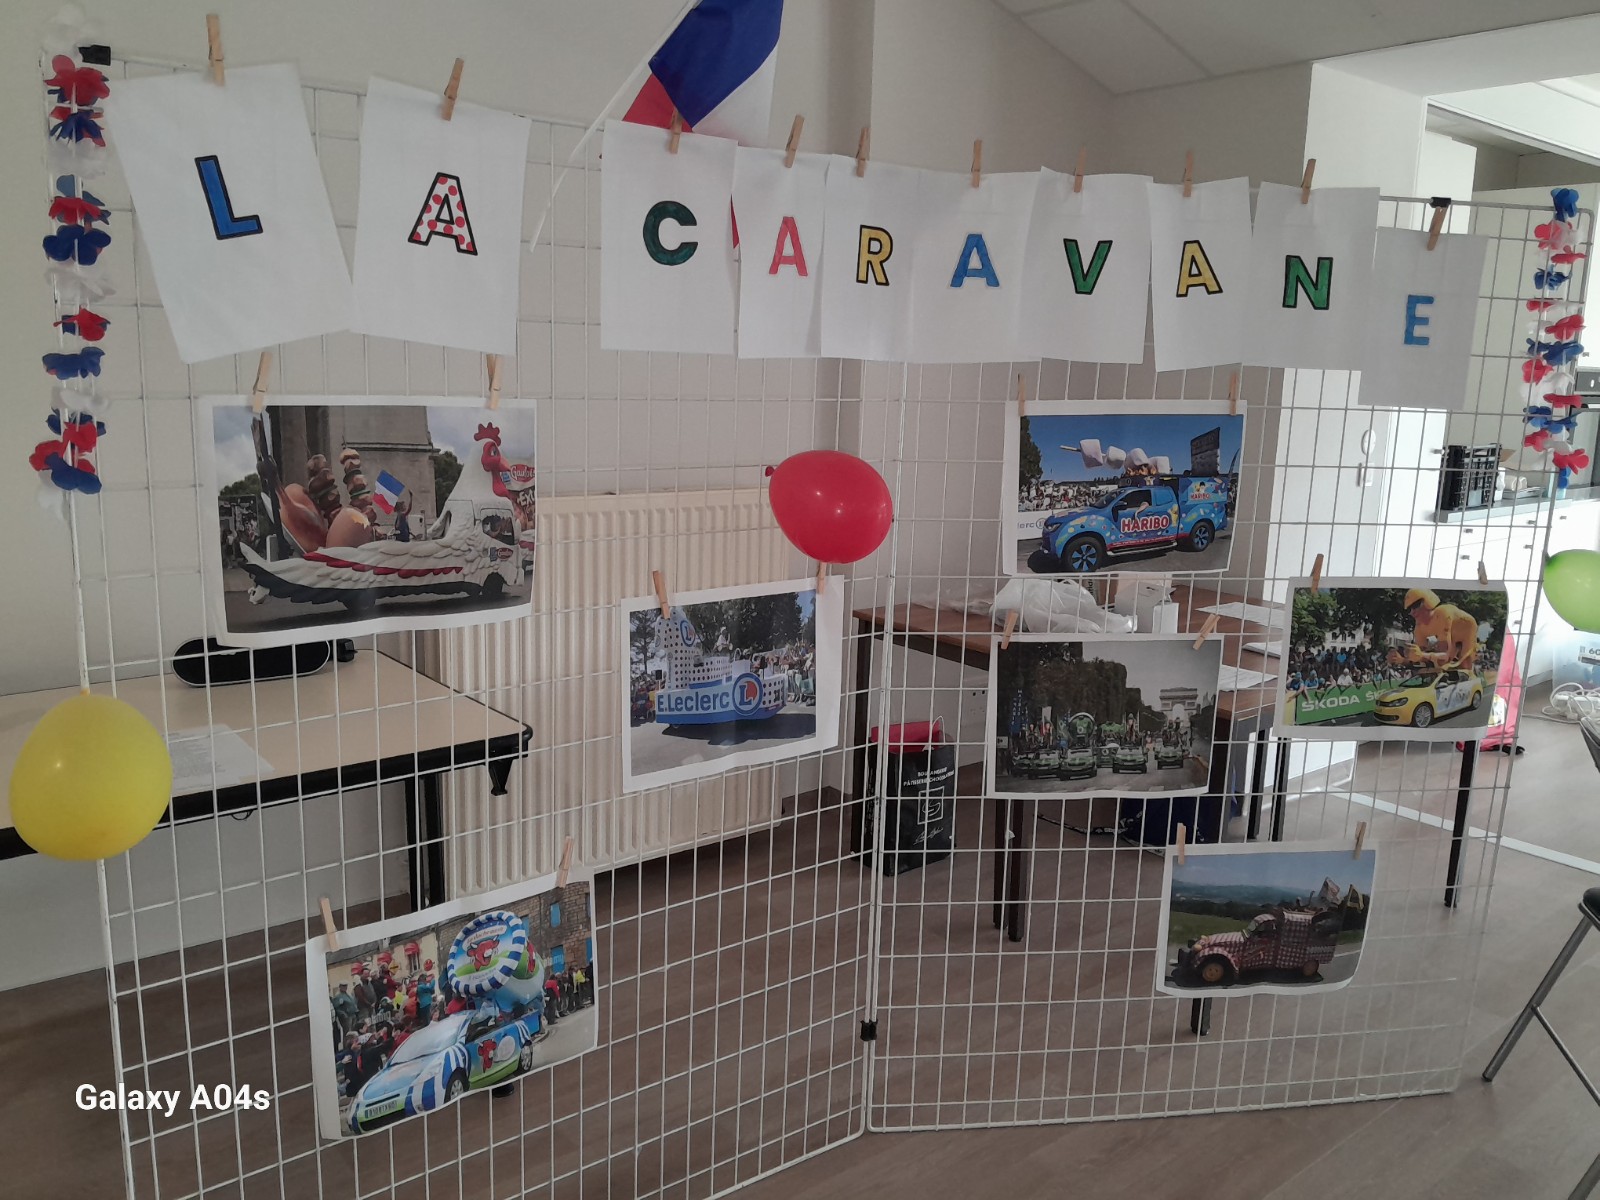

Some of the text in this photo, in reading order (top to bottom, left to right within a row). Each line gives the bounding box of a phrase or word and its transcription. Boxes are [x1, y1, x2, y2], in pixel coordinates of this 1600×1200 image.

[194, 154, 1435, 347] LA CARAVANE
[1120, 514, 1170, 533] HARIBO
[657, 691, 729, 712] E.Leclerc
